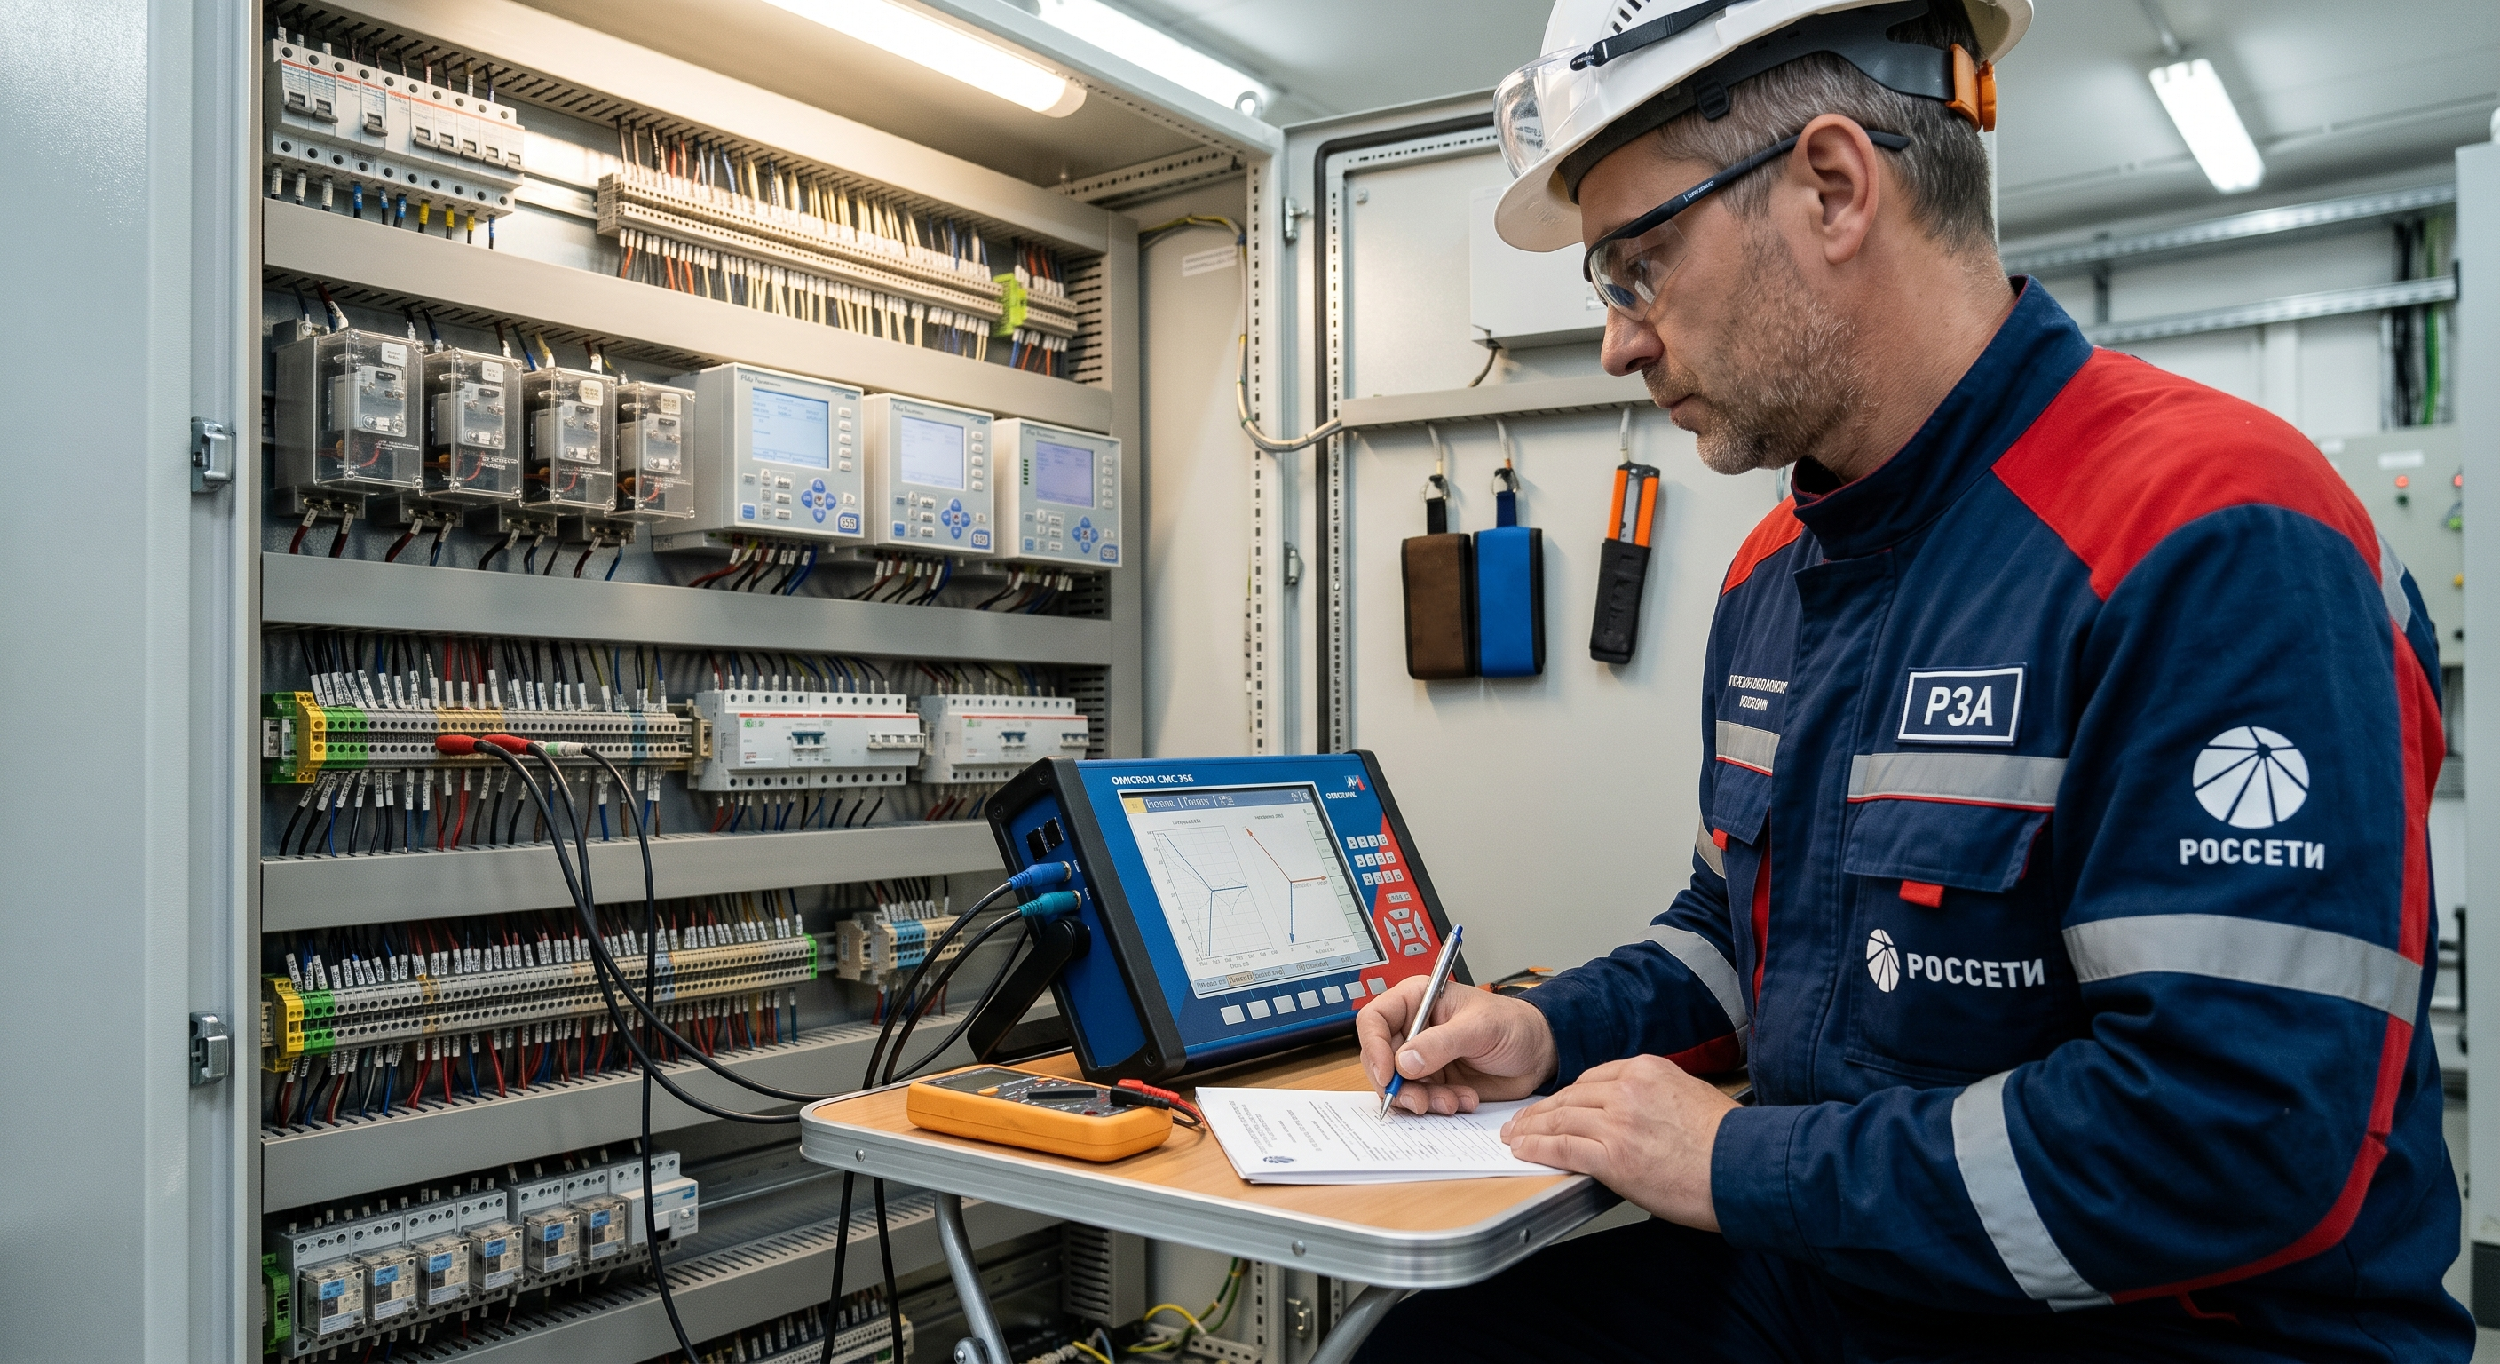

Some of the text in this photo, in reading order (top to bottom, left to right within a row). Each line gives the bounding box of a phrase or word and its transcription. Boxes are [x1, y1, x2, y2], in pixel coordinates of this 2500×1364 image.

[1924, 685, 1993, 727] РЗА
[1157, 774, 1178, 784] CMC
[2179, 838, 2325, 871] РОССЕТИ
[1906, 952, 2046, 988] РОССЕТИ
